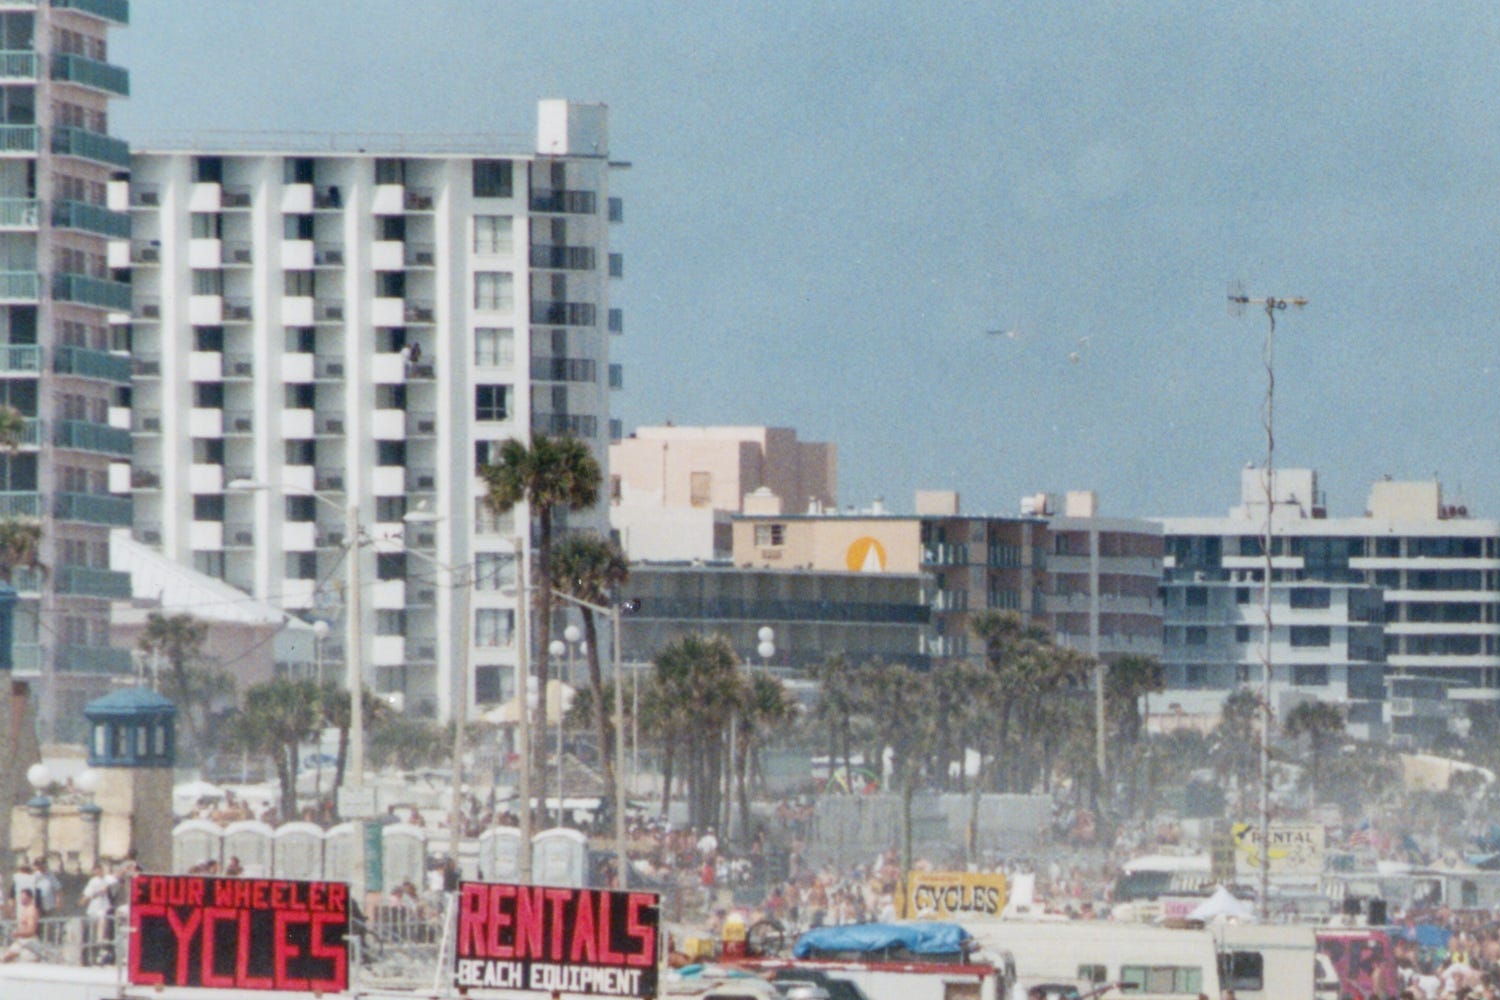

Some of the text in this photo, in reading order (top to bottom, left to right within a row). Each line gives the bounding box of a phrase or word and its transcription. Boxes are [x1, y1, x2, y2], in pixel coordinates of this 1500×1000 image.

[130, 876, 347, 912] FOUR WHEELER
[914, 884, 999, 914] CYCLES
[458, 882, 657, 967] RENTALS
[128, 905, 347, 993] CYCLES
[458, 958, 642, 995] BEACH EQUIPMENT
